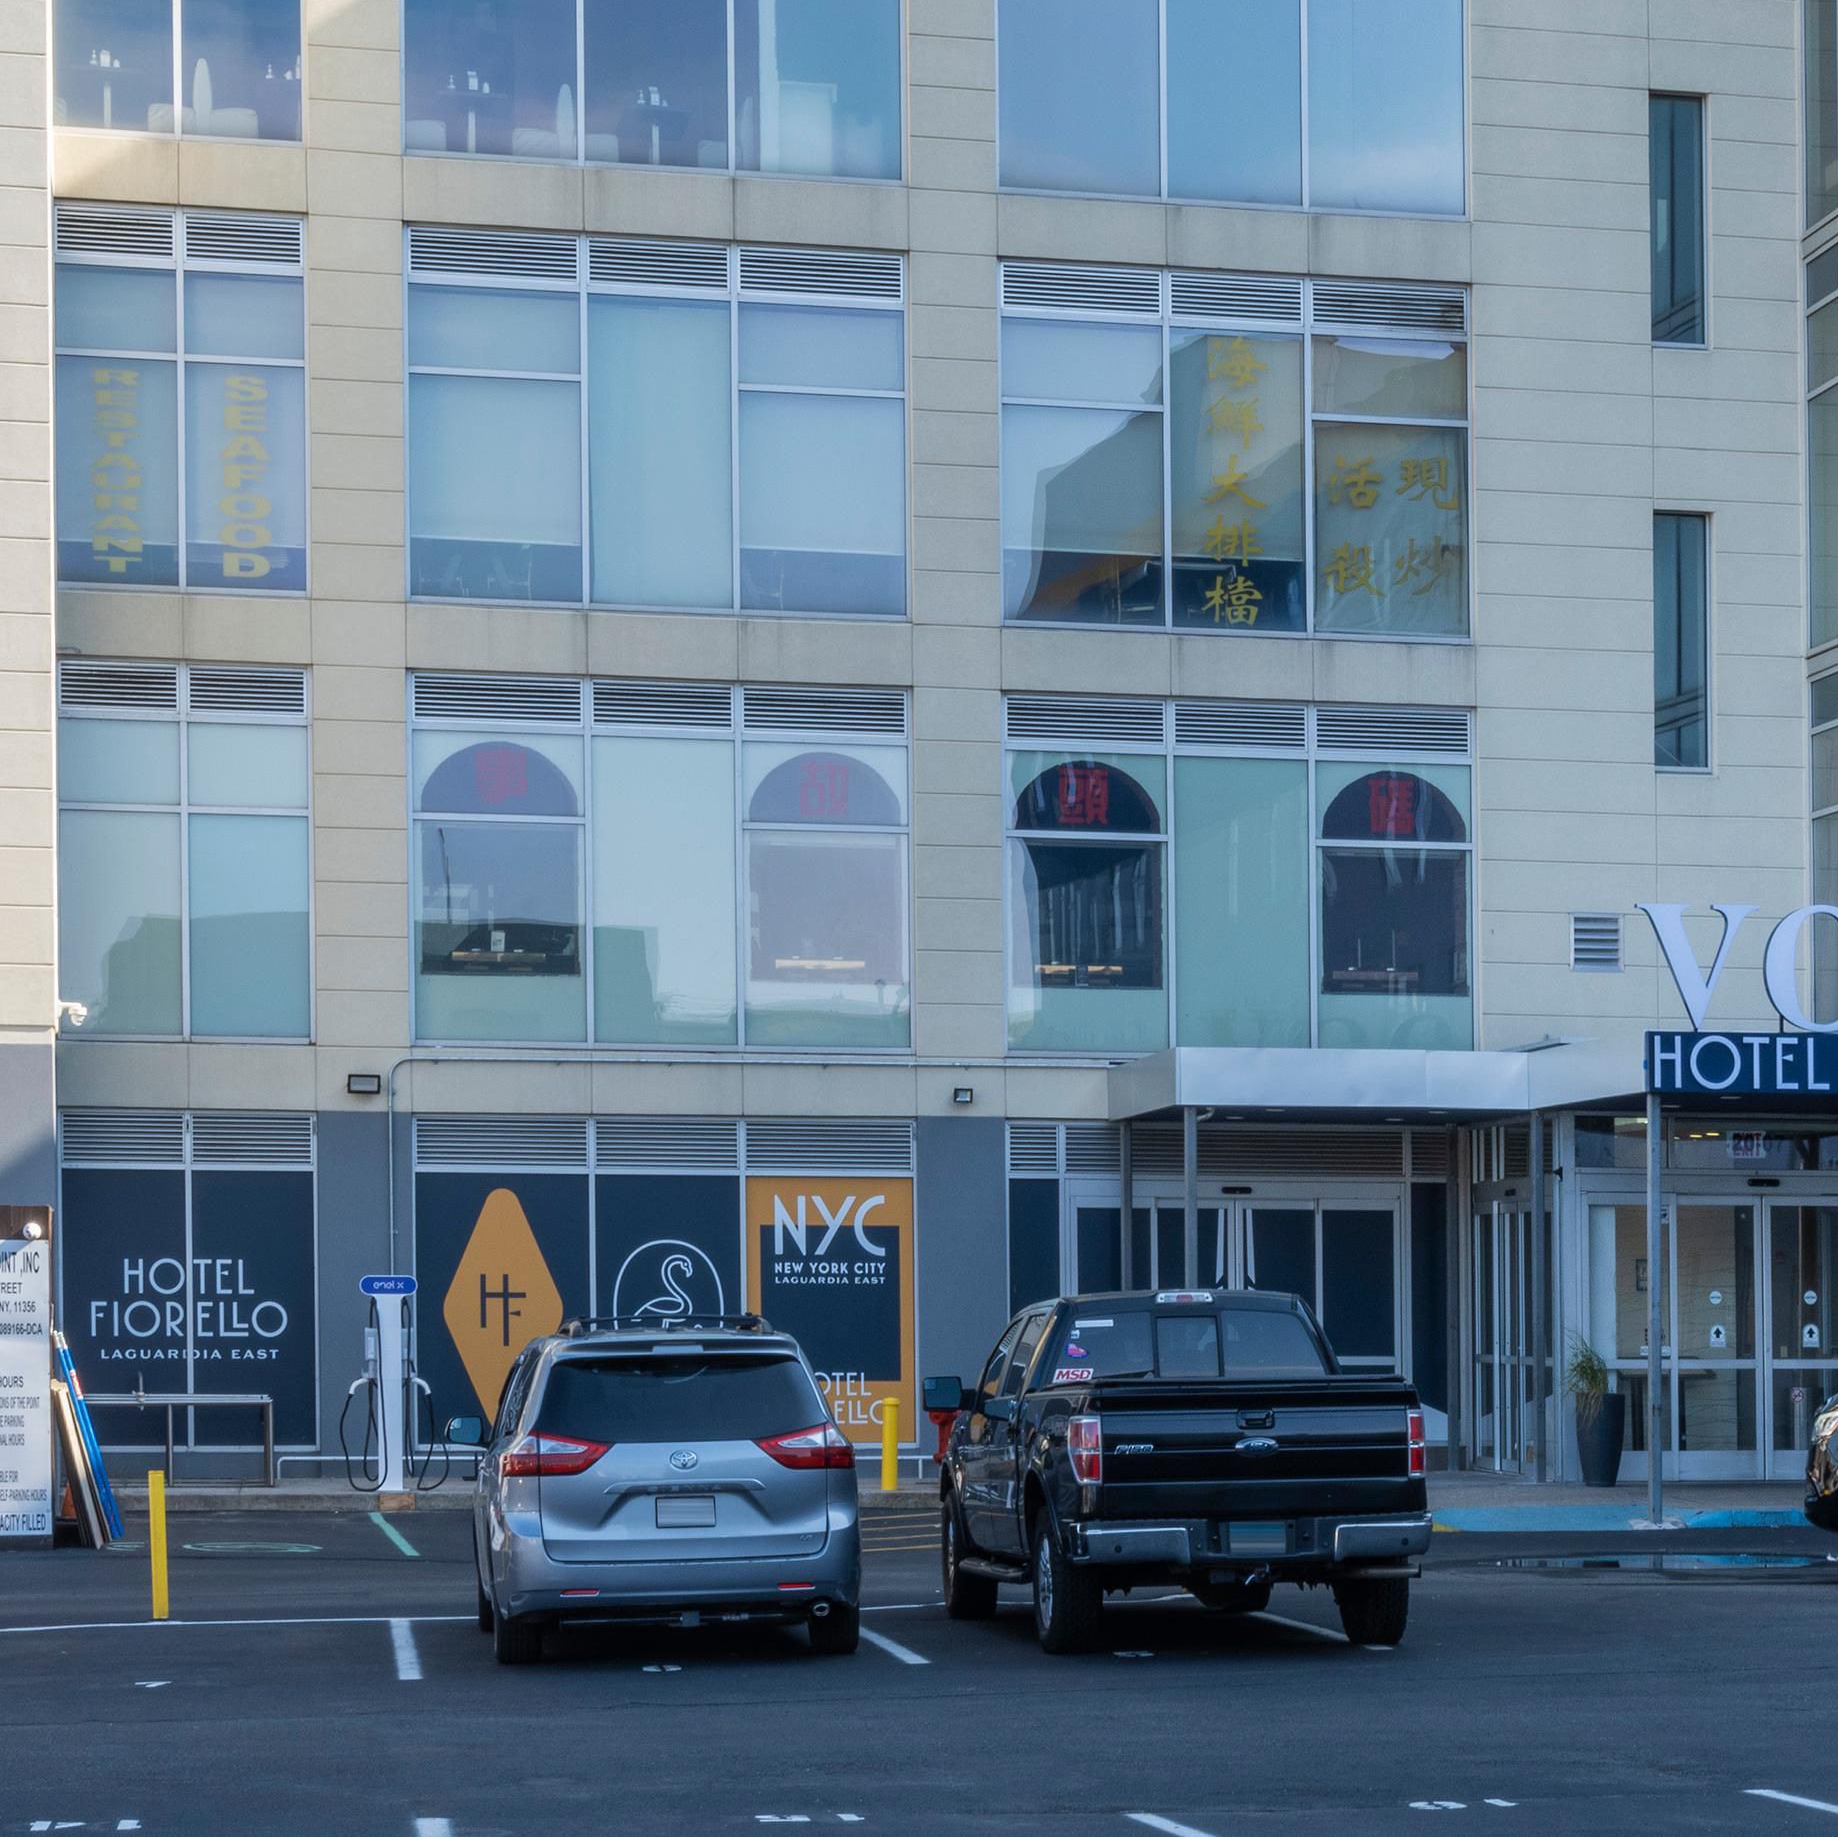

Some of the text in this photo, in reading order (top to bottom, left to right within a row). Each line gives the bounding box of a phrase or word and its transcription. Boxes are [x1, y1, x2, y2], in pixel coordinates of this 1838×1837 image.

[91, 369, 143, 574] RESTAURANT
[219, 375, 272, 578] SEAFOOD
[1200, 336, 1269, 626] 海鮮大排檔
[1653, 1034, 1830, 1092] HOTEL
[774, 1194, 886, 1256] NYC
[0, 1252, 17, 1273] INT
[774, 1262, 886, 1274] NEW YORK CITY
[123, 1258, 255, 1294] HOTEL
[775, 1276, 886, 1284] LAGUARDIA EAST
[0, 1282, 23, 1294] REET
[14, 1301, 36, 1313] 11356
[90, 1300, 288, 1338] FIORELLO
[100, 1348, 279, 1360] LAGUARDIA EAST
[1056, 1369, 1091, 1381] MSD
[22, 1513, 46, 1531] FILLED
